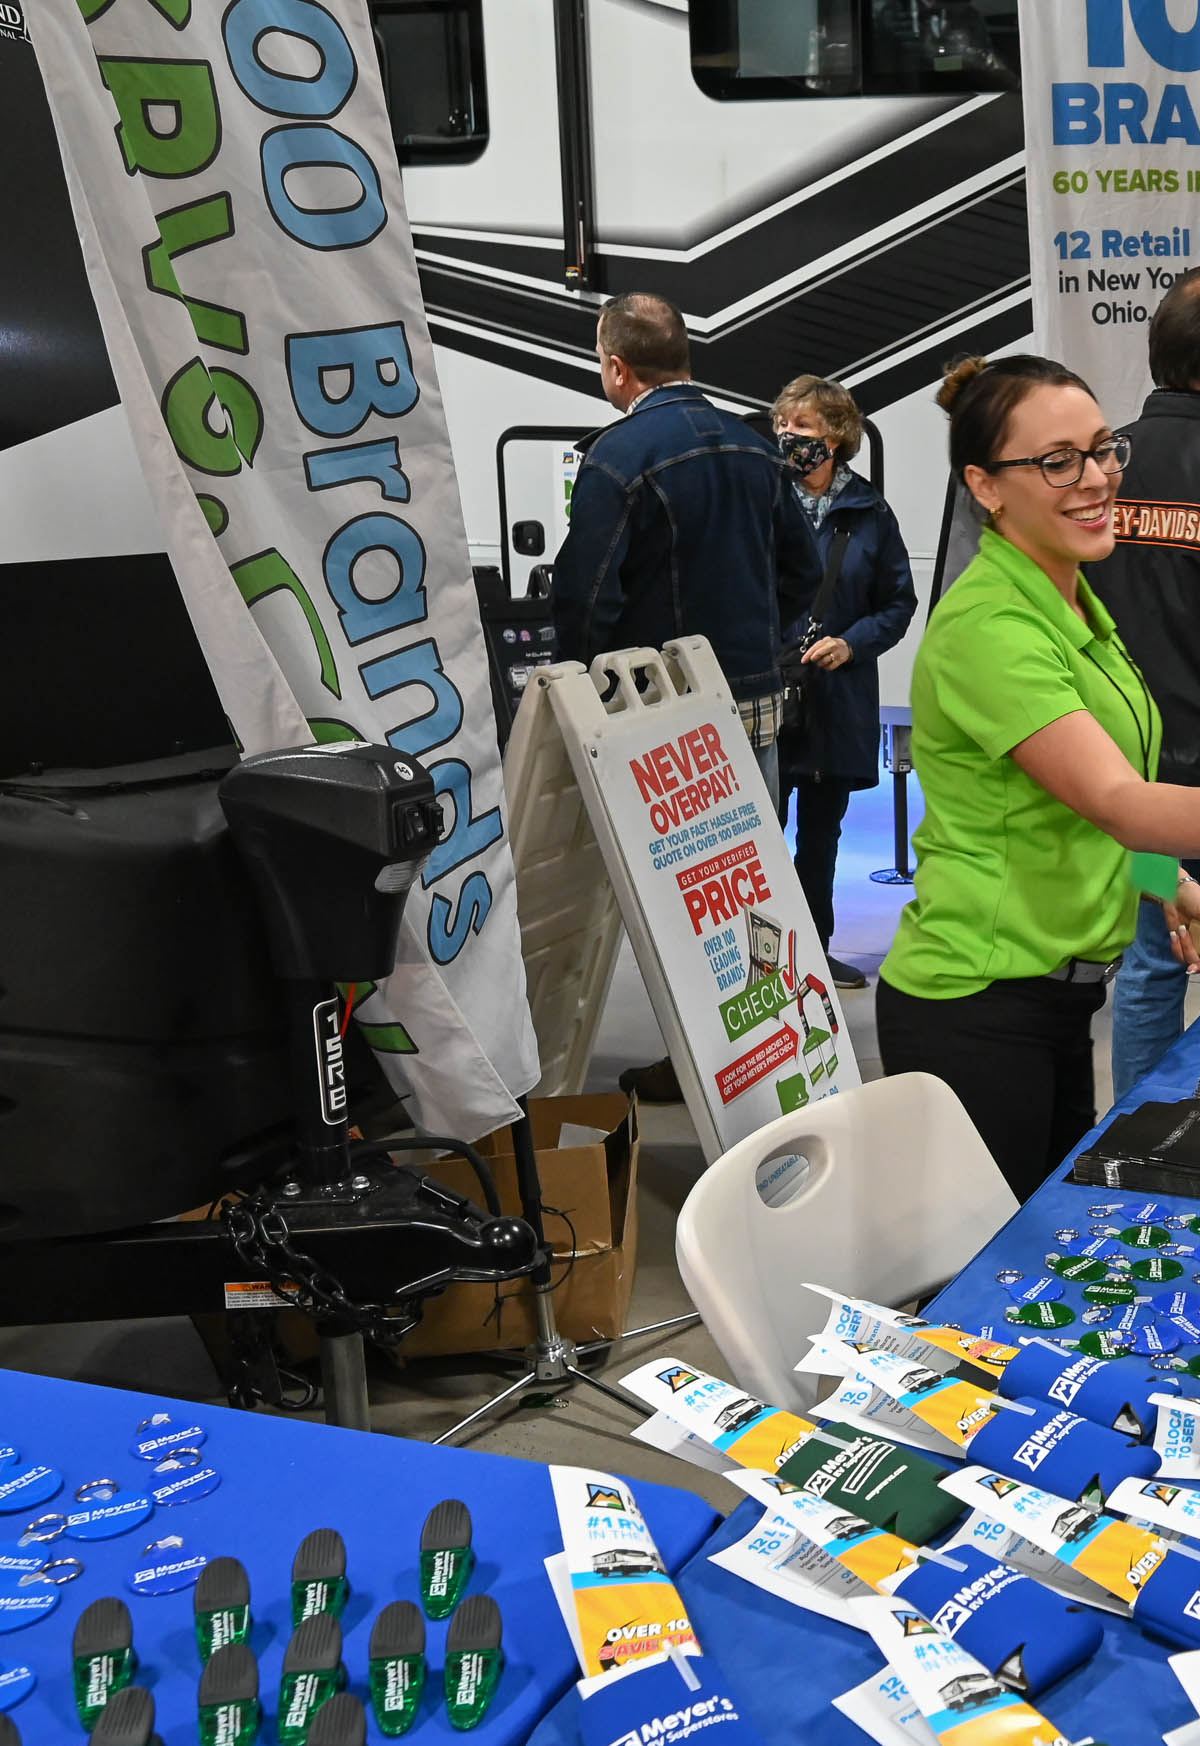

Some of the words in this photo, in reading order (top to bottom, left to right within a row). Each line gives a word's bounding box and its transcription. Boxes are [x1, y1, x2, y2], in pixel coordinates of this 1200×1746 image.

[1052, 170, 1089, 195] 60
[1096, 169, 1180, 193] YEARS
[1054, 230, 1091, 260] 12
[1101, 227, 1190, 258] Retail
[1058, 270, 1080, 293] in
[1087, 269, 1141, 292] New
[1146, 266, 1189, 291] Yor
[284, 321, 503, 966] Brands
[629, 722, 729, 804] NEVER
[650, 763, 740, 835] OVERPAY!
[648, 838, 667, 856] GET
[666, 829, 691, 847] YOUR
[690, 821, 710, 839] FAST
[711, 811, 739, 830] HASSLE
[737, 802, 757, 818] FREE
[653, 850, 684, 870] QUOTE
[683, 844, 697, 858] ON
[696, 833, 718, 852] OVER
[718, 828, 733, 843] 100
[732, 814, 762, 836] BRANDS
[680, 872, 697, 886] GET
[698, 861, 720, 880] YOUR
[720, 845, 755, 868] VERIFIED
[682, 858, 772, 937] PRICE
[703, 935, 724, 957] OVER
[721, 927, 736, 946] 100
[709, 945, 741, 975] LEADING
[716, 963, 746, 992] BRANDS
[726, 978, 784, 1031] CHECK
[722, 1071, 737, 1085] LOOK
[736, 1063, 747, 1077] FOR
[746, 1056, 757, 1070] THE
[782, 1033, 790, 1042] TO
[723, 1083, 734, 1096] GET
[733, 1072, 748, 1088] YOUR
[766, 1052, 781, 1067] PRICE
[684, 1390, 705, 1406] #1
[706, 1381, 727, 1394] RV
[957, 1407, 990, 1430] OVER
[157, 1426, 201, 1445] Meyer's
[1164, 1447, 1177, 1459] 12
[1178, 1445, 1192, 1459] TO
[170, 1468, 213, 1490] Meyer's
[92, 1498, 148, 1517] Meyer's
[1013, 1496, 1034, 1513] #1
[1182, 1499, 1200, 1517] #1
[588, 1516, 613, 1529] #1
[618, 1518, 644, 1532] RV
[973, 1521, 991, 1537] 12
[985, 1523, 1006, 1541] TO
[748, 1538, 767, 1550] 12
[758, 1540, 781, 1556] TO
[156, 1556, 206, 1575] Meyer's
[1125, 1551, 1162, 1585] OVER
[968, 1597, 984, 1611] RV
[607, 1622, 662, 1642] OVER
[598, 1639, 659, 1660] SAVE
[914, 1643, 940, 1659] #1
[880, 1677, 901, 1692] 12
[641, 1695, 734, 1743] Meyer's
[669, 1713, 738, 1743] Superstores
